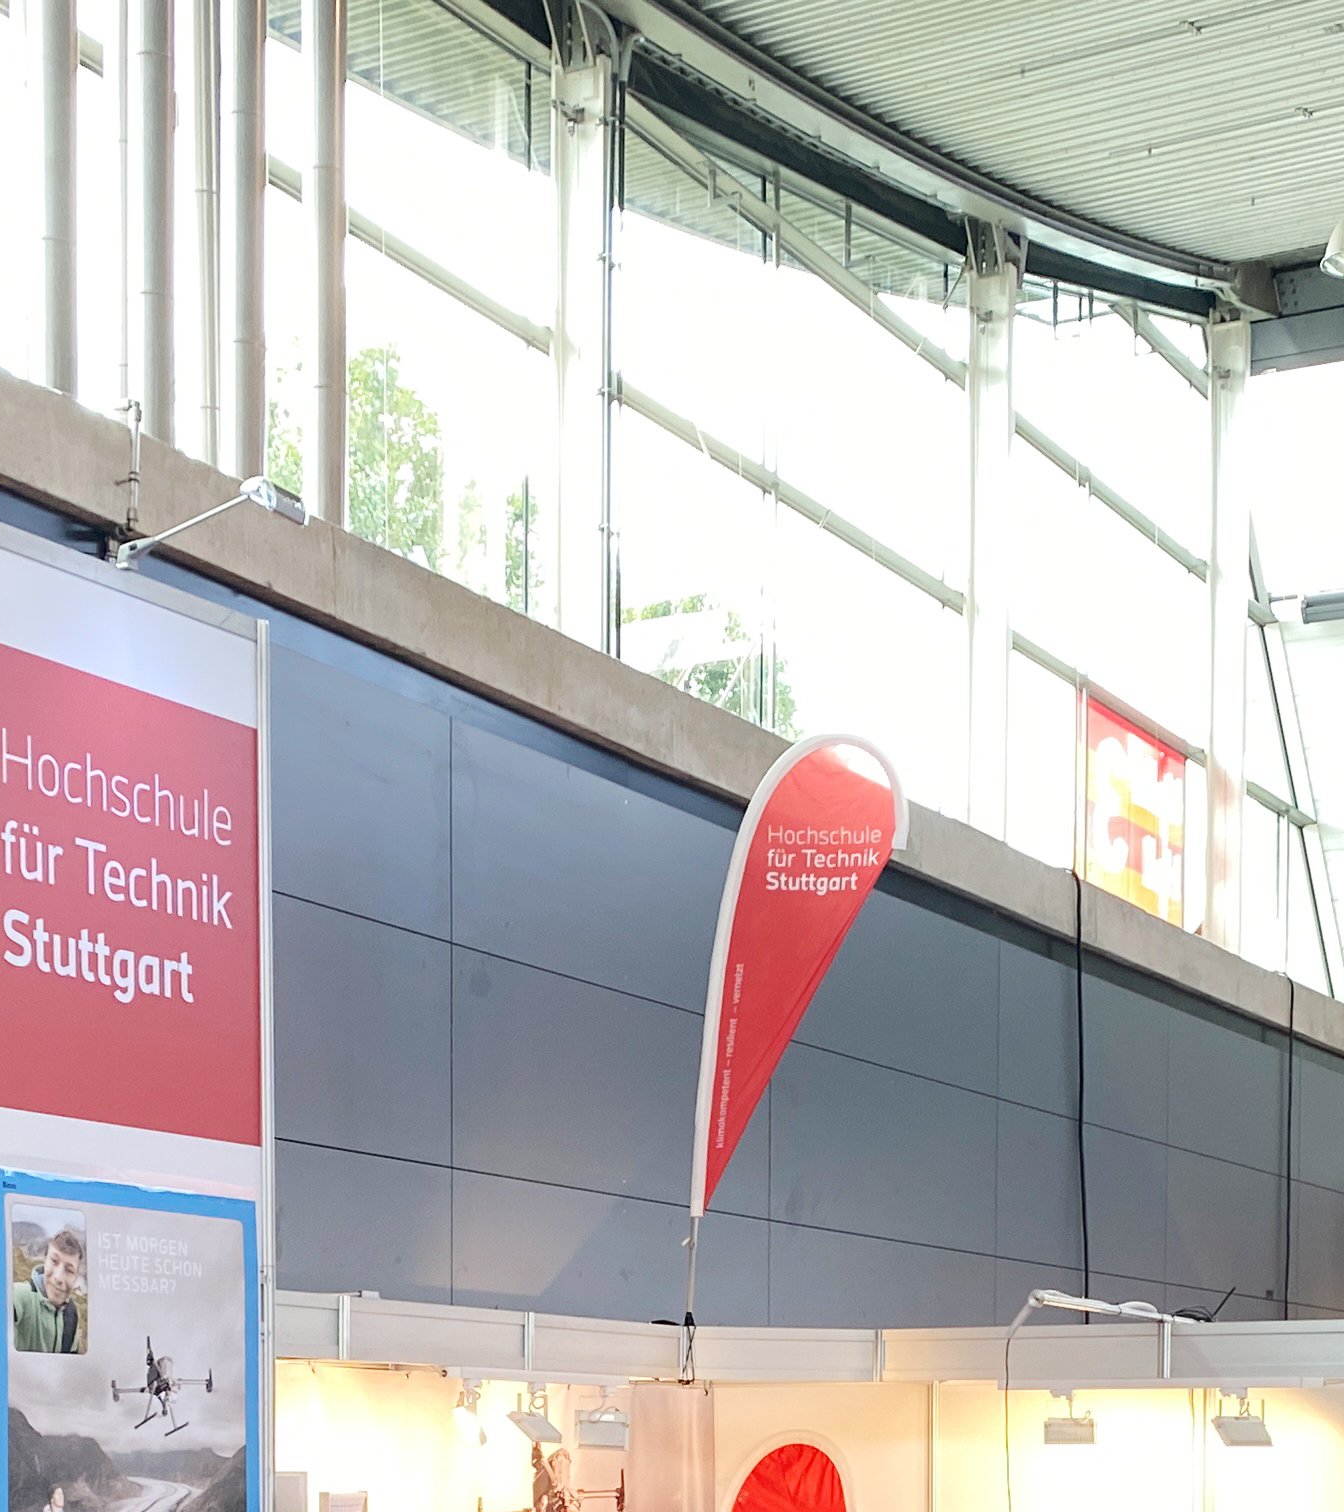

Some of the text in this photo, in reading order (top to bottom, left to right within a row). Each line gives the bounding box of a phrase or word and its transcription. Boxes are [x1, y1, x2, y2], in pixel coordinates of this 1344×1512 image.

[1, 727, 233, 846] Hochschule
[767, 825, 882, 846] Hochschule
[767, 848, 879, 868] für Technik
[1, 820, 233, 930] für Technik
[765, 871, 858, 896] Stuttgart
[3, 909, 194, 1003] Stuttgart
[716, 1069, 732, 1149] klimakompetent
[97, 1231, 188, 1256] IST MORGEN
[98, 1253, 202, 1279] HEUTE SCHON
[98, 1272, 177, 1295] MESSBAR?
